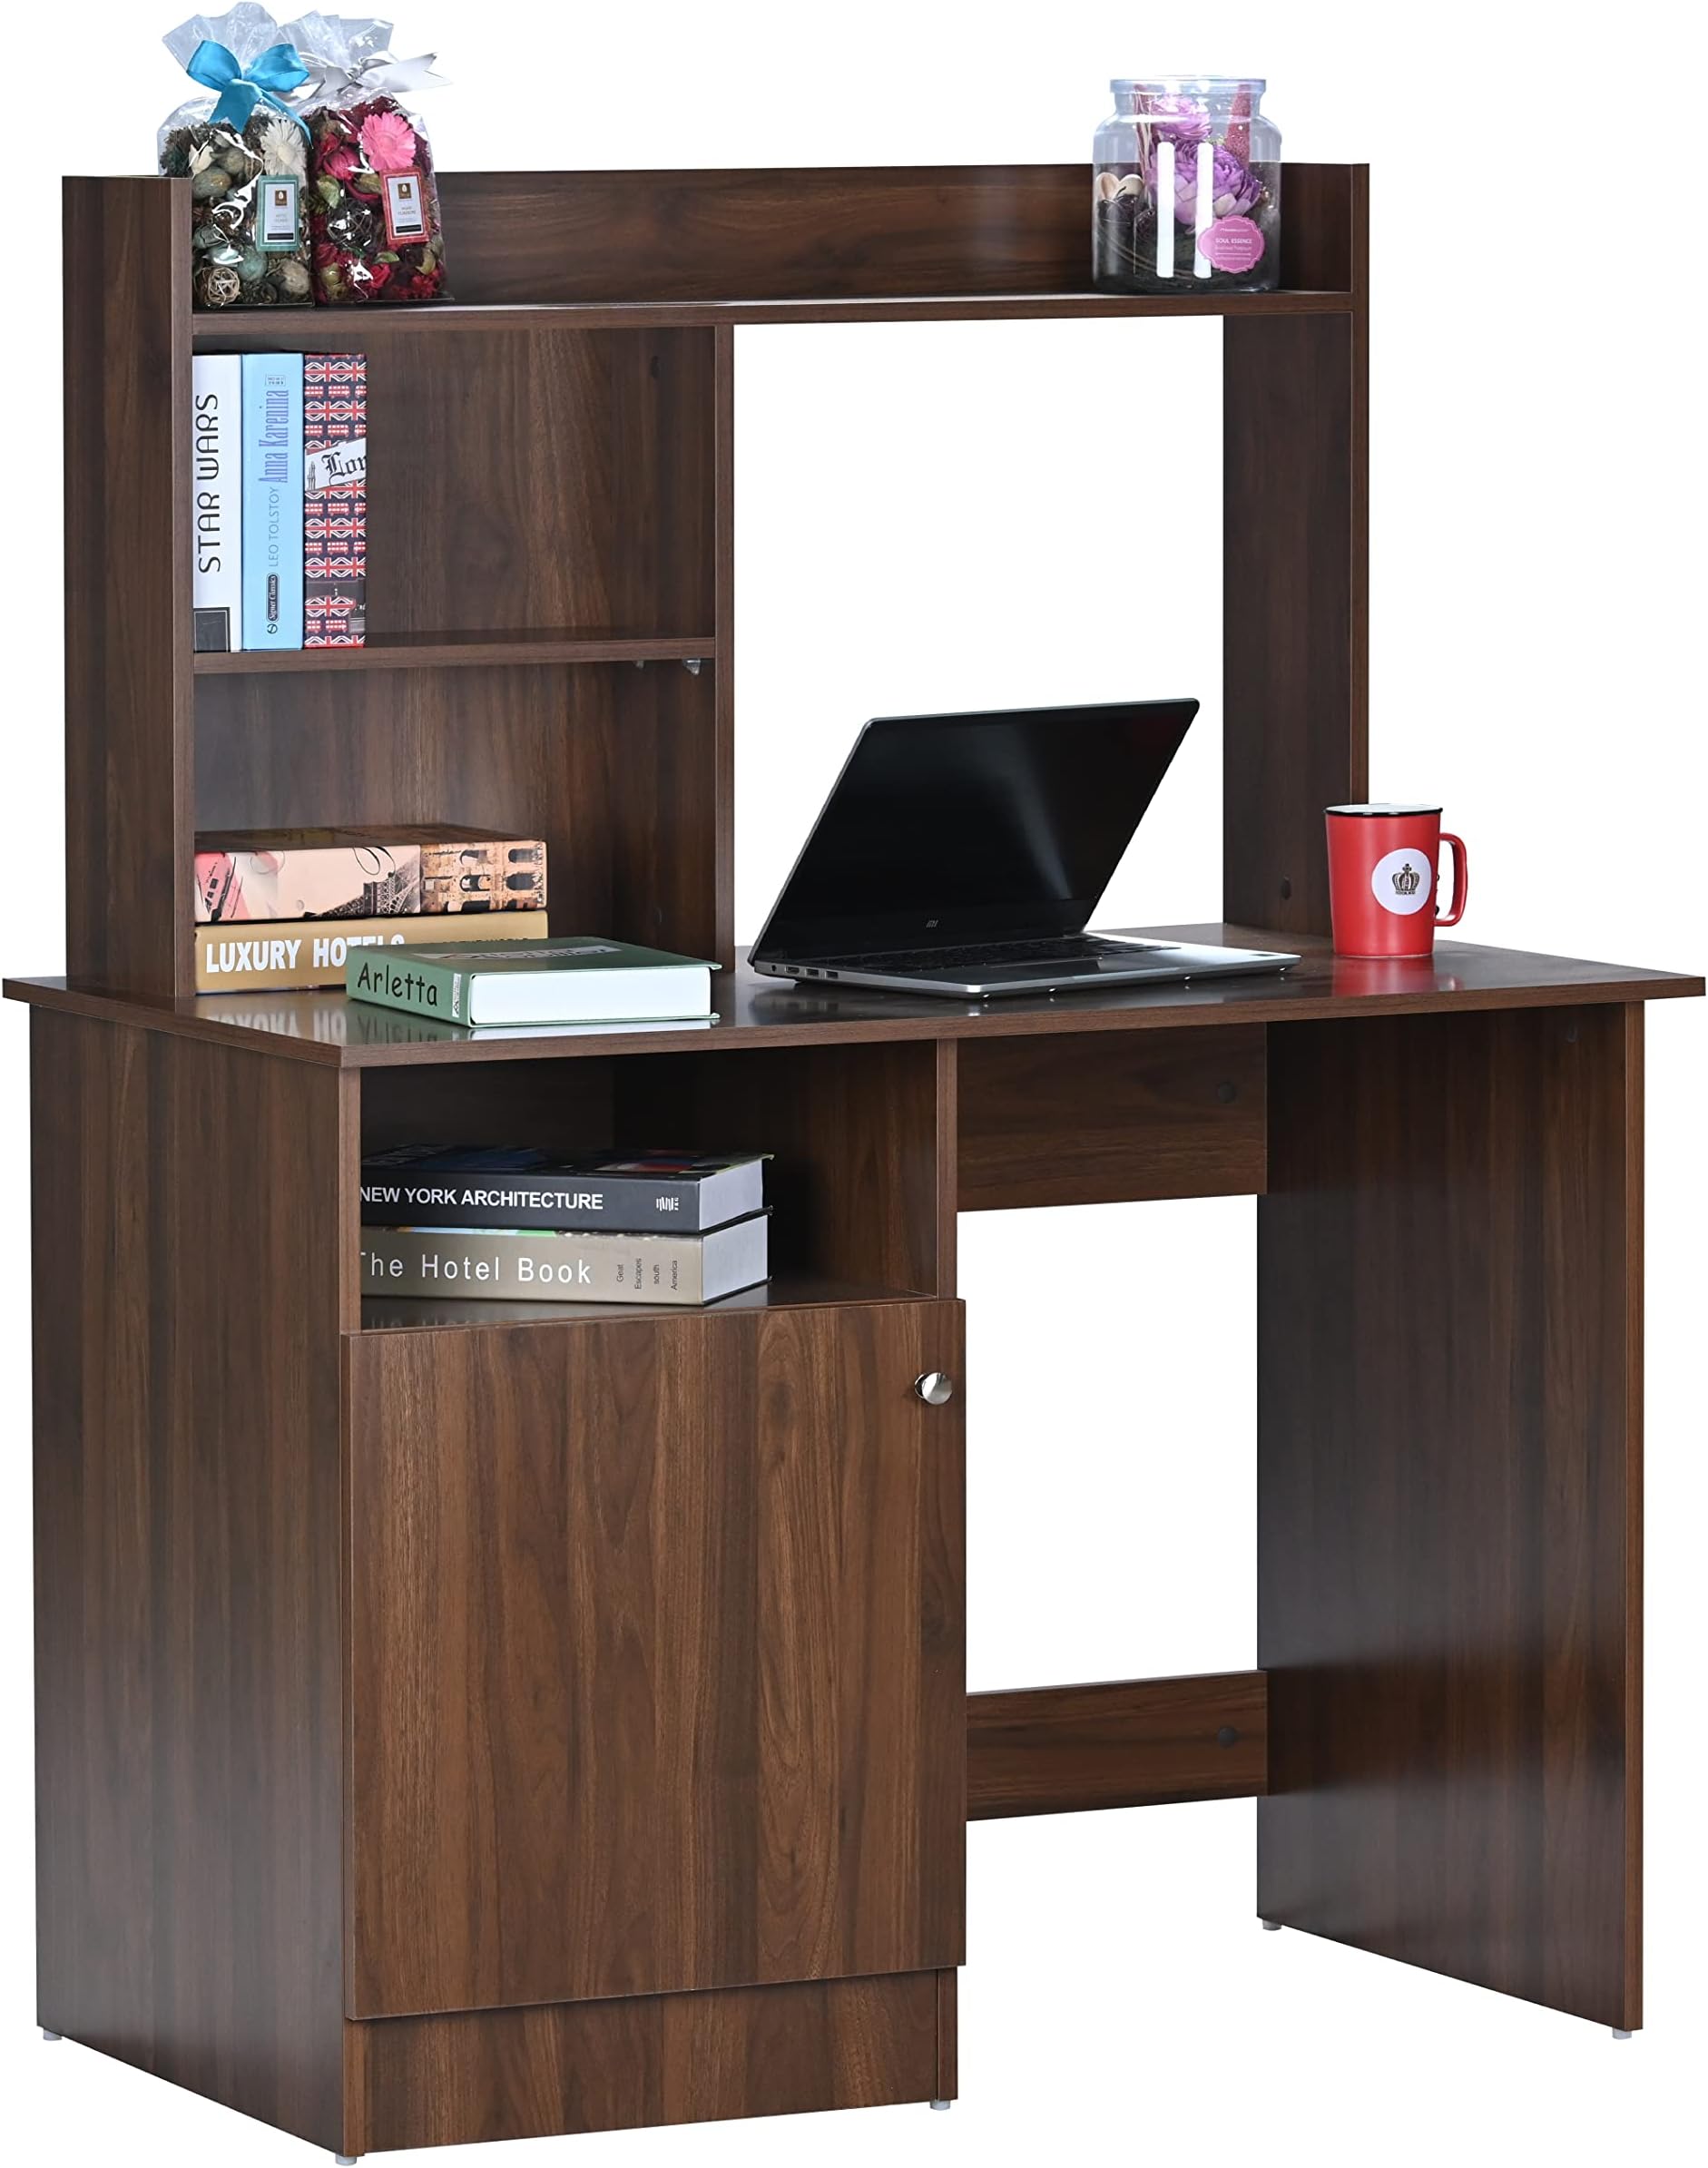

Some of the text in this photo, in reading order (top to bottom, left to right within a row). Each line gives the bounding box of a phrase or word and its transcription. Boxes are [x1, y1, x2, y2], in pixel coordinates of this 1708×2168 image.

[259, 390, 290, 446] Karenina
[195, 394, 221, 574] STAR WARS
[259, 453, 289, 483] Anna
[269, 486, 280, 567] LEO TOLSTOY
[206, 939, 302, 974] LUXURY
[358, 962, 437, 1007] Arletta
[360, 1186, 604, 1210] NEW YORK ARCHITECTURE
[360, 1251, 592, 1284] he Hotel Book
